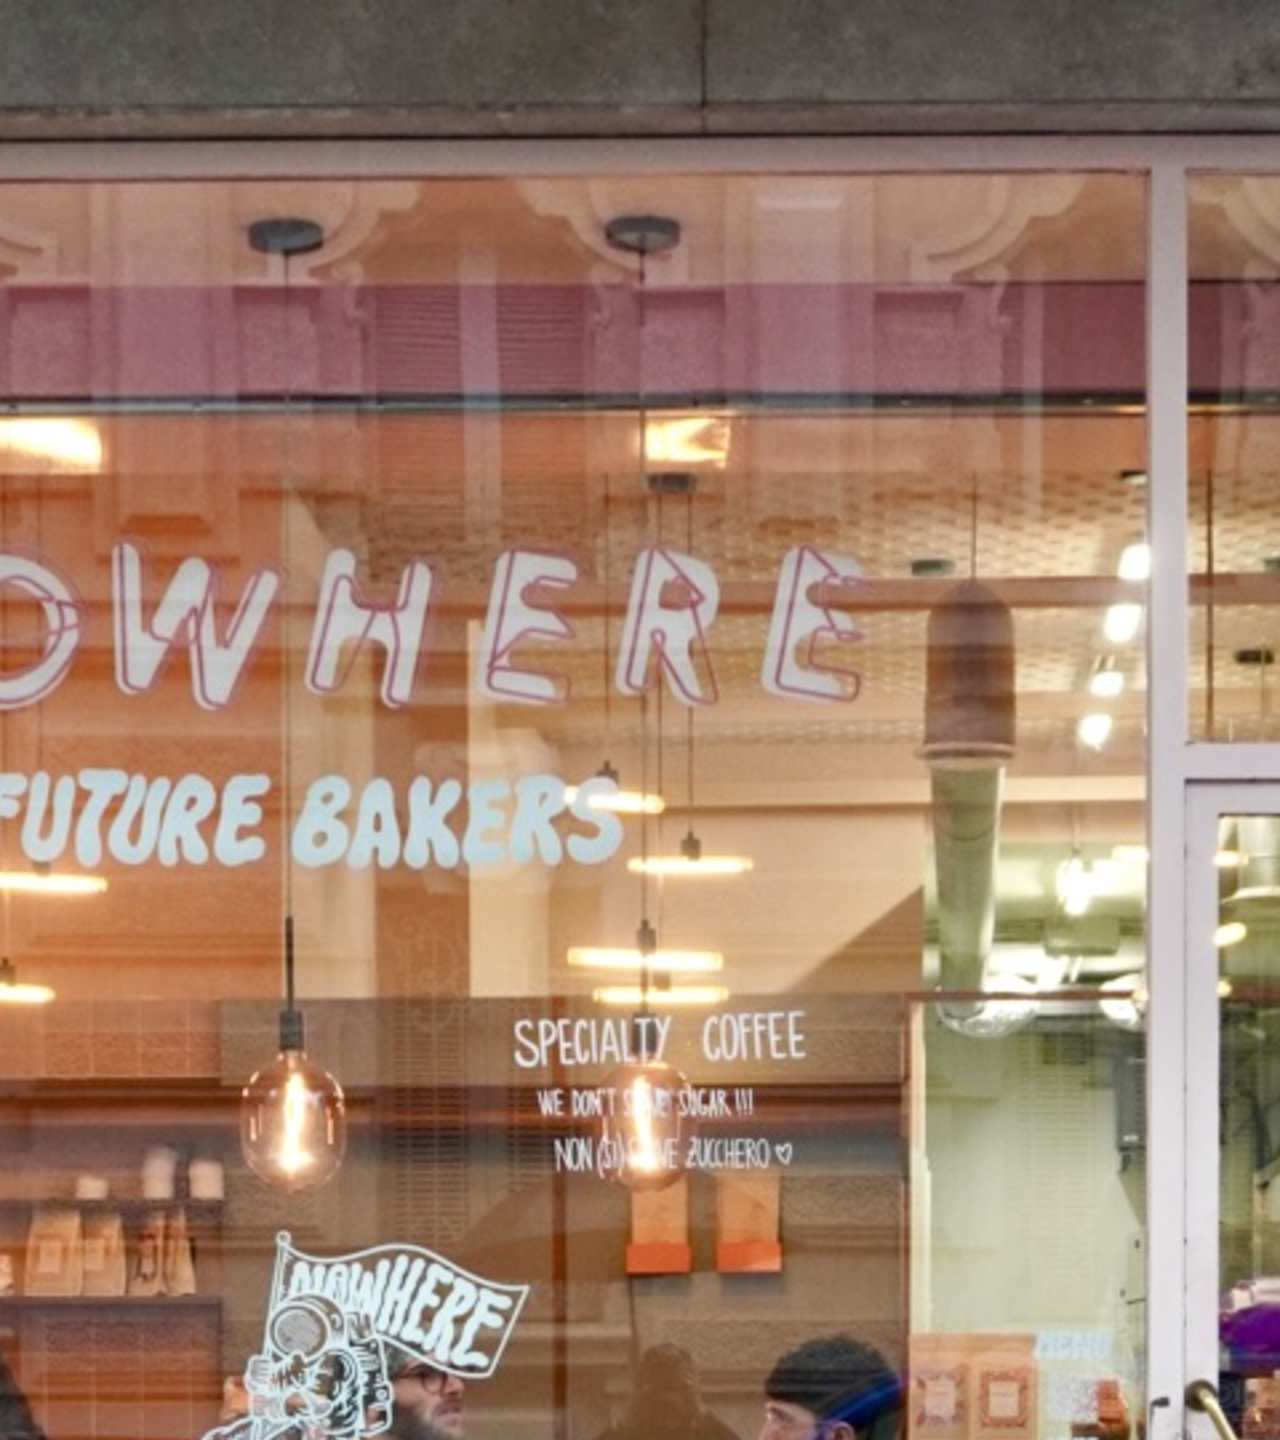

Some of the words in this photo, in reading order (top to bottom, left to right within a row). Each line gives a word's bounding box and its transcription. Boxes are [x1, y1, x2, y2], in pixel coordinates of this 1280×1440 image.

[291, 773, 626, 870] BAKERS
[514, 1016, 671, 1068] SPECIALTY
[703, 1010, 807, 1061] COFFEE
[536, 1088, 564, 1116] WE
[572, 1088, 616, 1116] DON'T
[678, 1086, 732, 1117] SUGAR
[554, 1137, 593, 1172] NON
[685, 1136, 770, 1171] ZUCCHERO
[288, 1254, 513, 1368] NOWHERE
